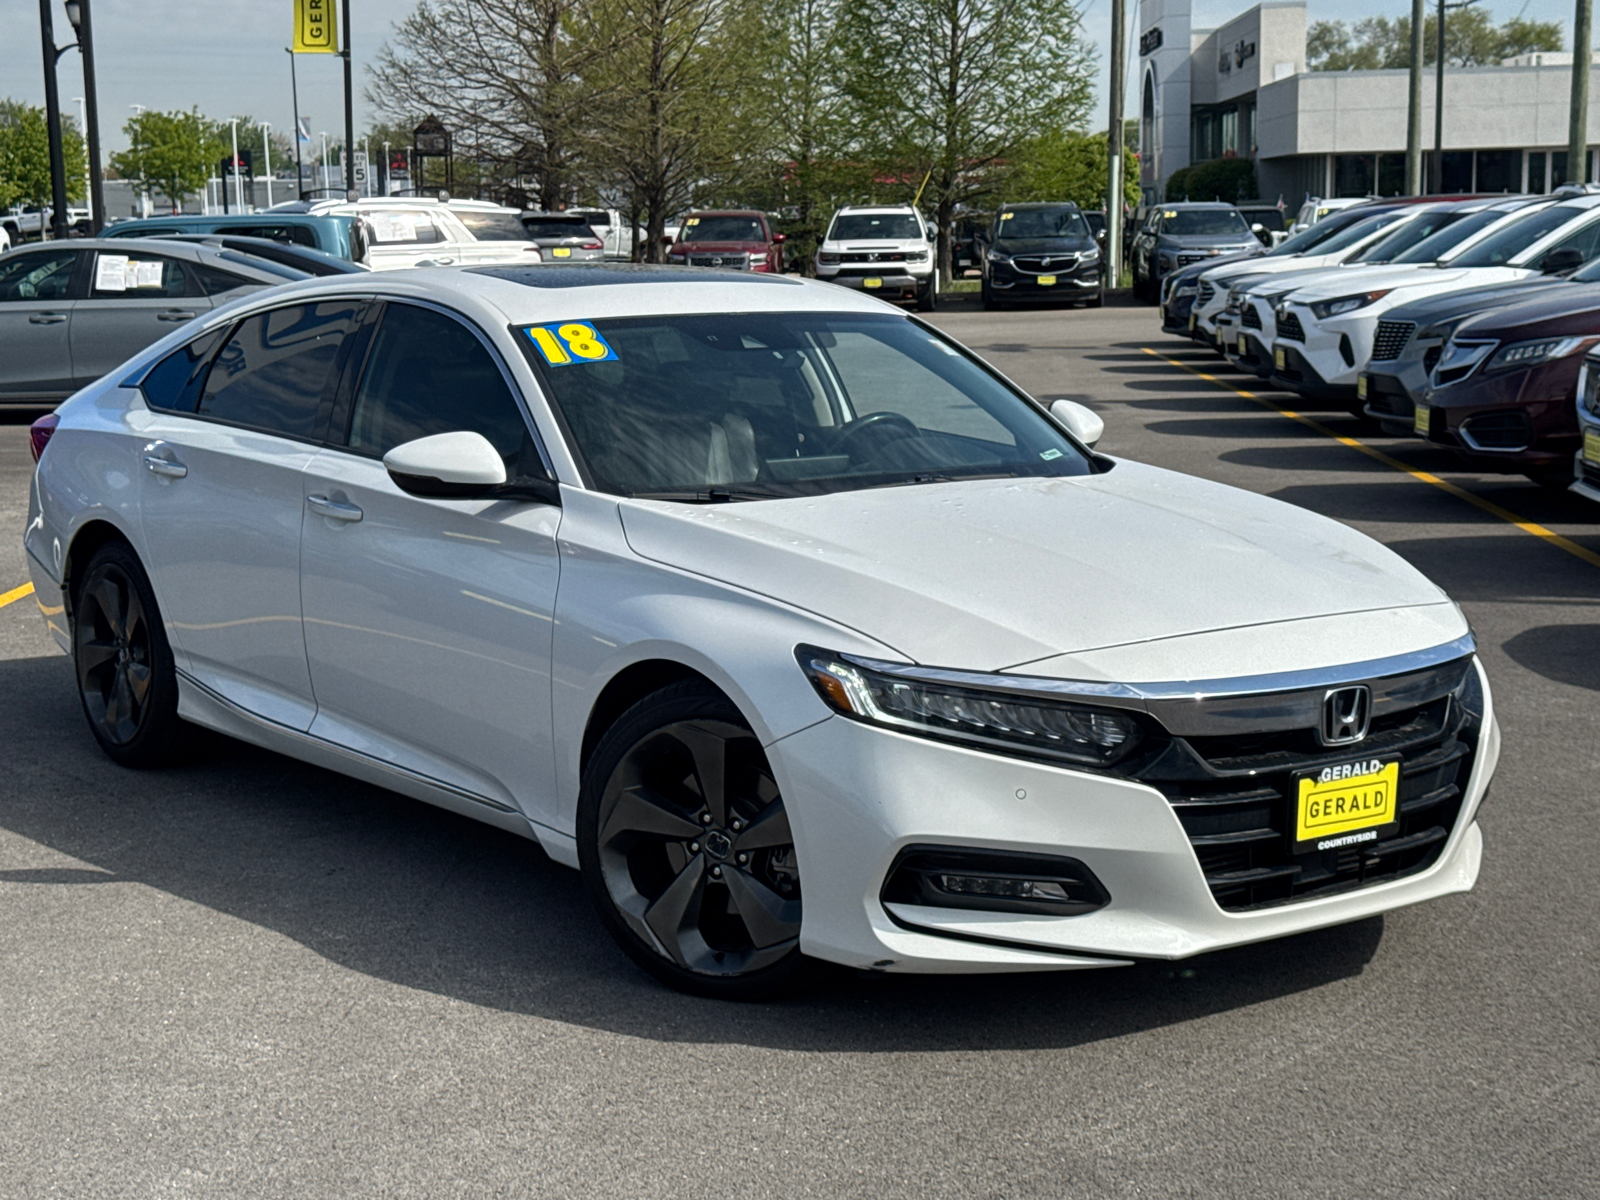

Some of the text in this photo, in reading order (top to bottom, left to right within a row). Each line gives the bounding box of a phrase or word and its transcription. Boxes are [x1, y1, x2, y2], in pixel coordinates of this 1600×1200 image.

[529, 323, 609, 365] 18
[1320, 759, 1381, 783] GERALD
[1309, 790, 1384, 818] GERALD
[1317, 830, 1378, 850] COUNTRYSIDE
